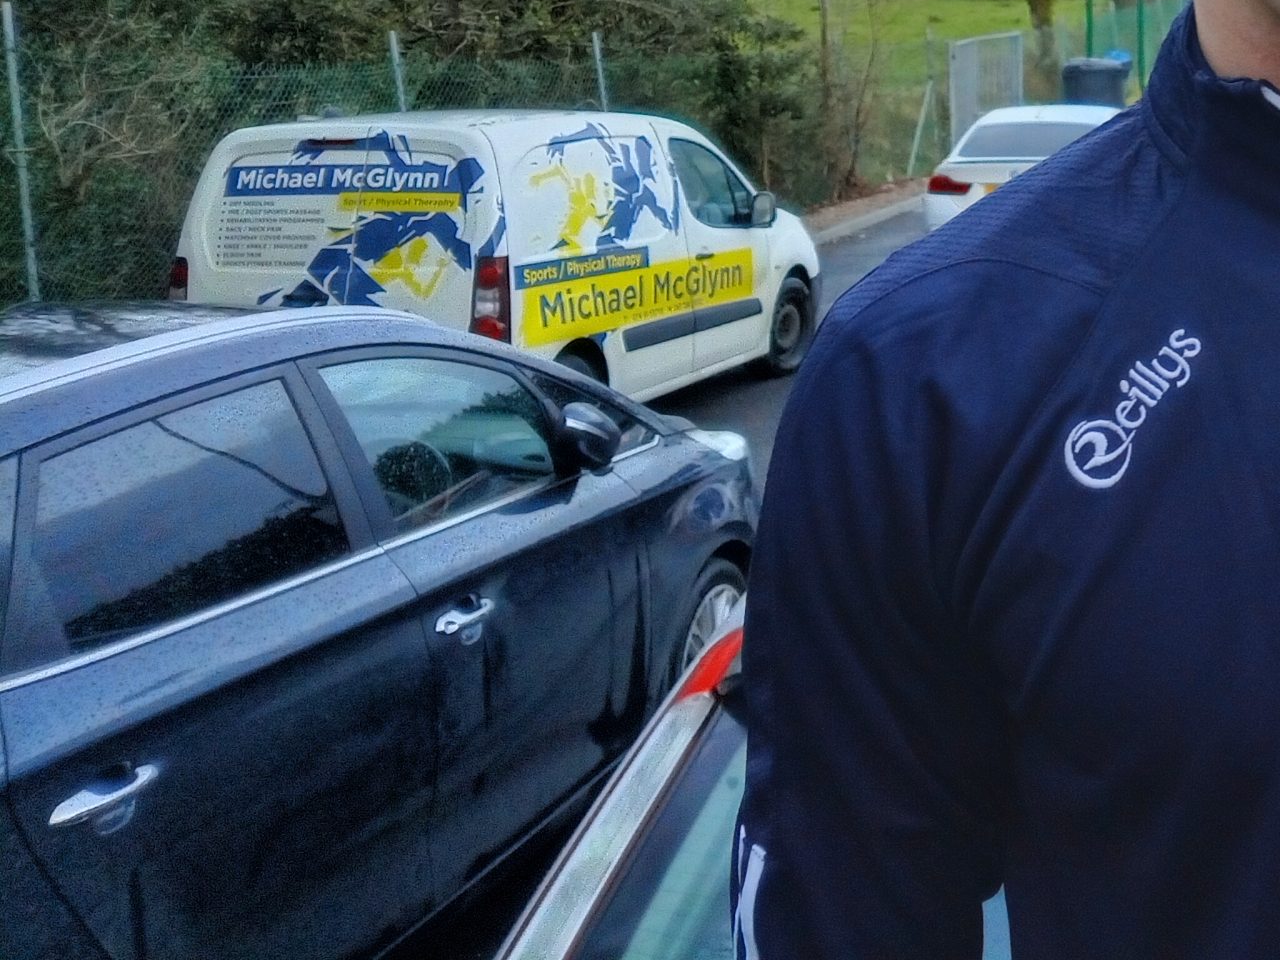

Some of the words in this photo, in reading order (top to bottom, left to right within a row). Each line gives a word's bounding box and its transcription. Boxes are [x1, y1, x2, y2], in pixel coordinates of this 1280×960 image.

[236, 167, 326, 190] Michael
[331, 167, 440, 192] McGlynn
[375, 197, 411, 208] Physical
[522, 266, 558, 285] Sports
[566, 256, 606, 277] Physical
[606, 253, 642, 269] Therapy
[539, 274, 644, 328] Michael
[653, 264, 743, 305] McGlynn
